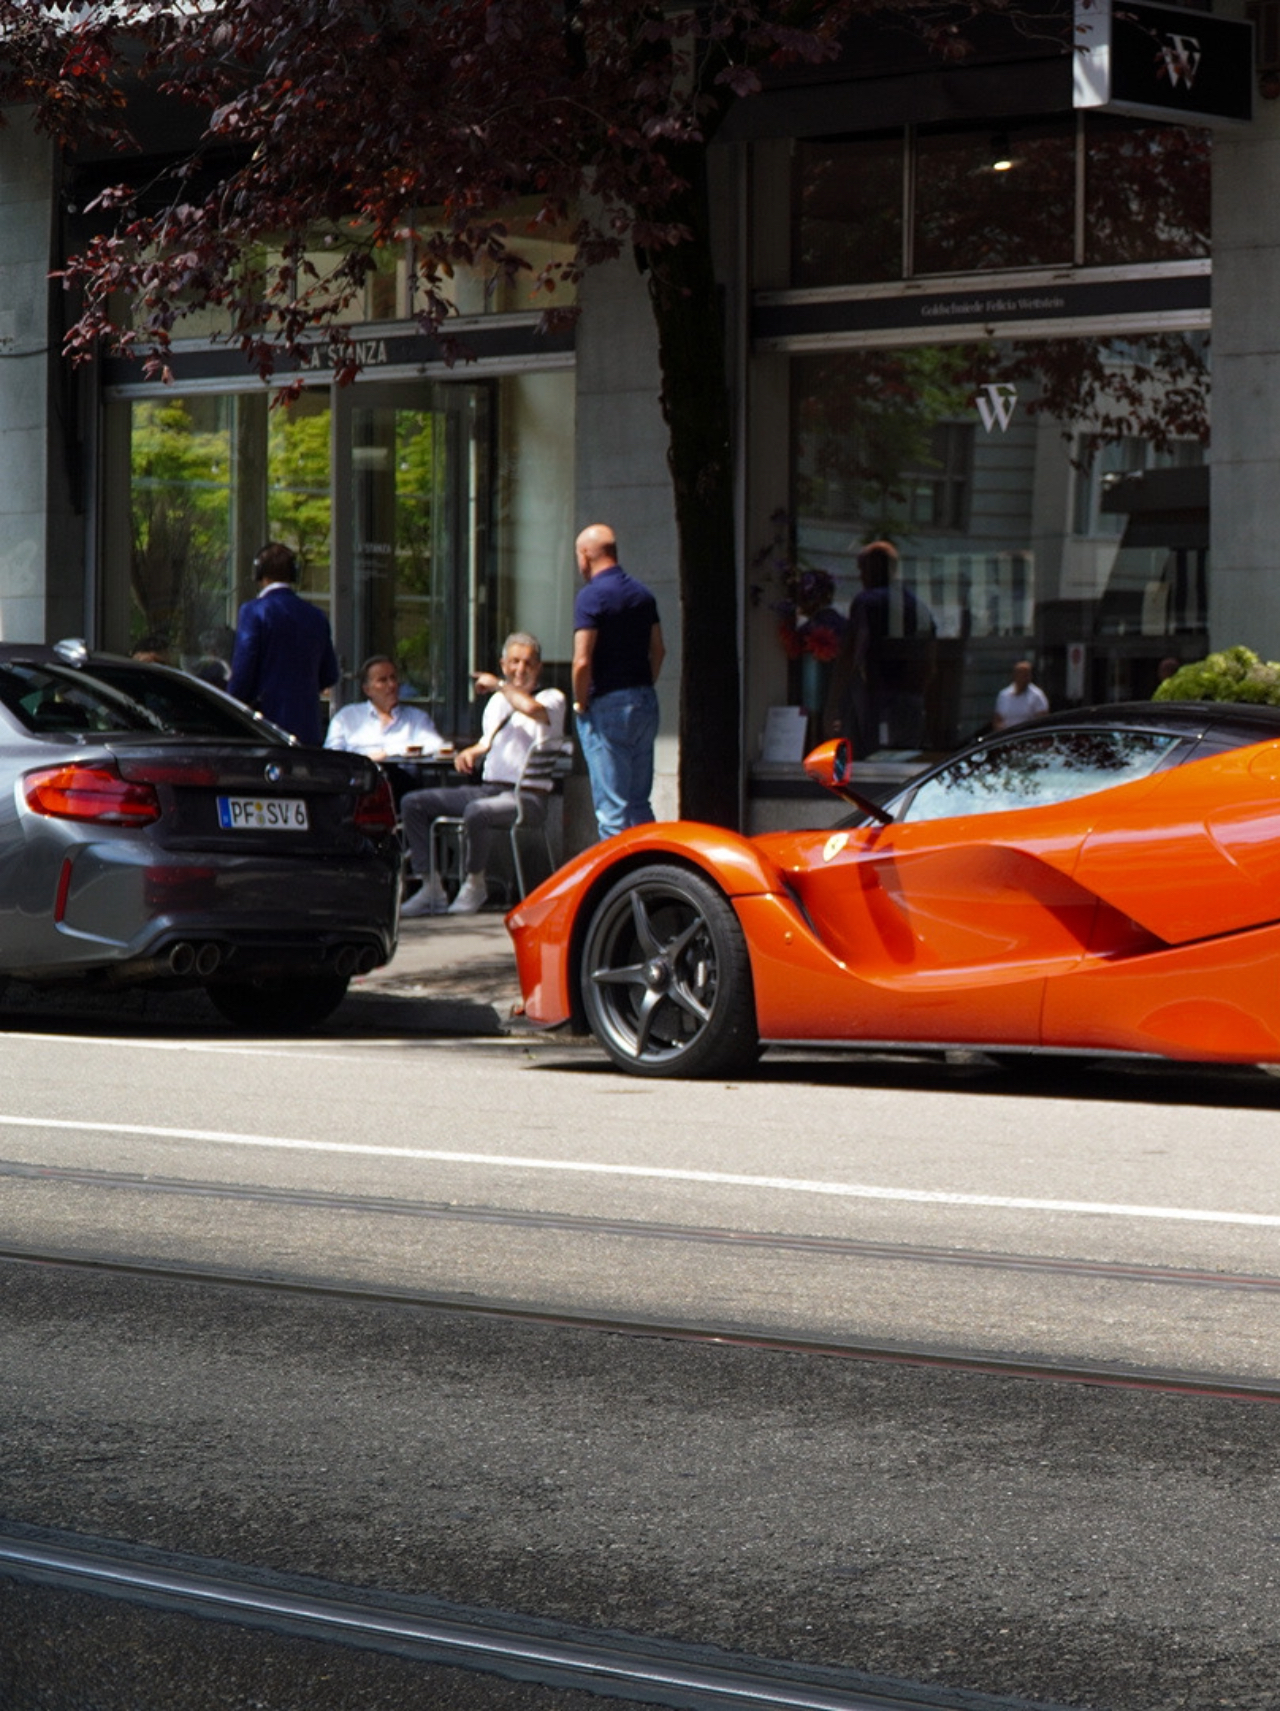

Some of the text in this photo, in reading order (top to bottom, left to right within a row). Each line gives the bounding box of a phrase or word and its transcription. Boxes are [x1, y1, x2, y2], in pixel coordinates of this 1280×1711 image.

[921, 301, 984, 317] Goldschmiede
[1018, 297, 1065, 310] Wettstein
[327, 340, 388, 367] STANZA
[231, 801, 305, 825] PF SV 6
